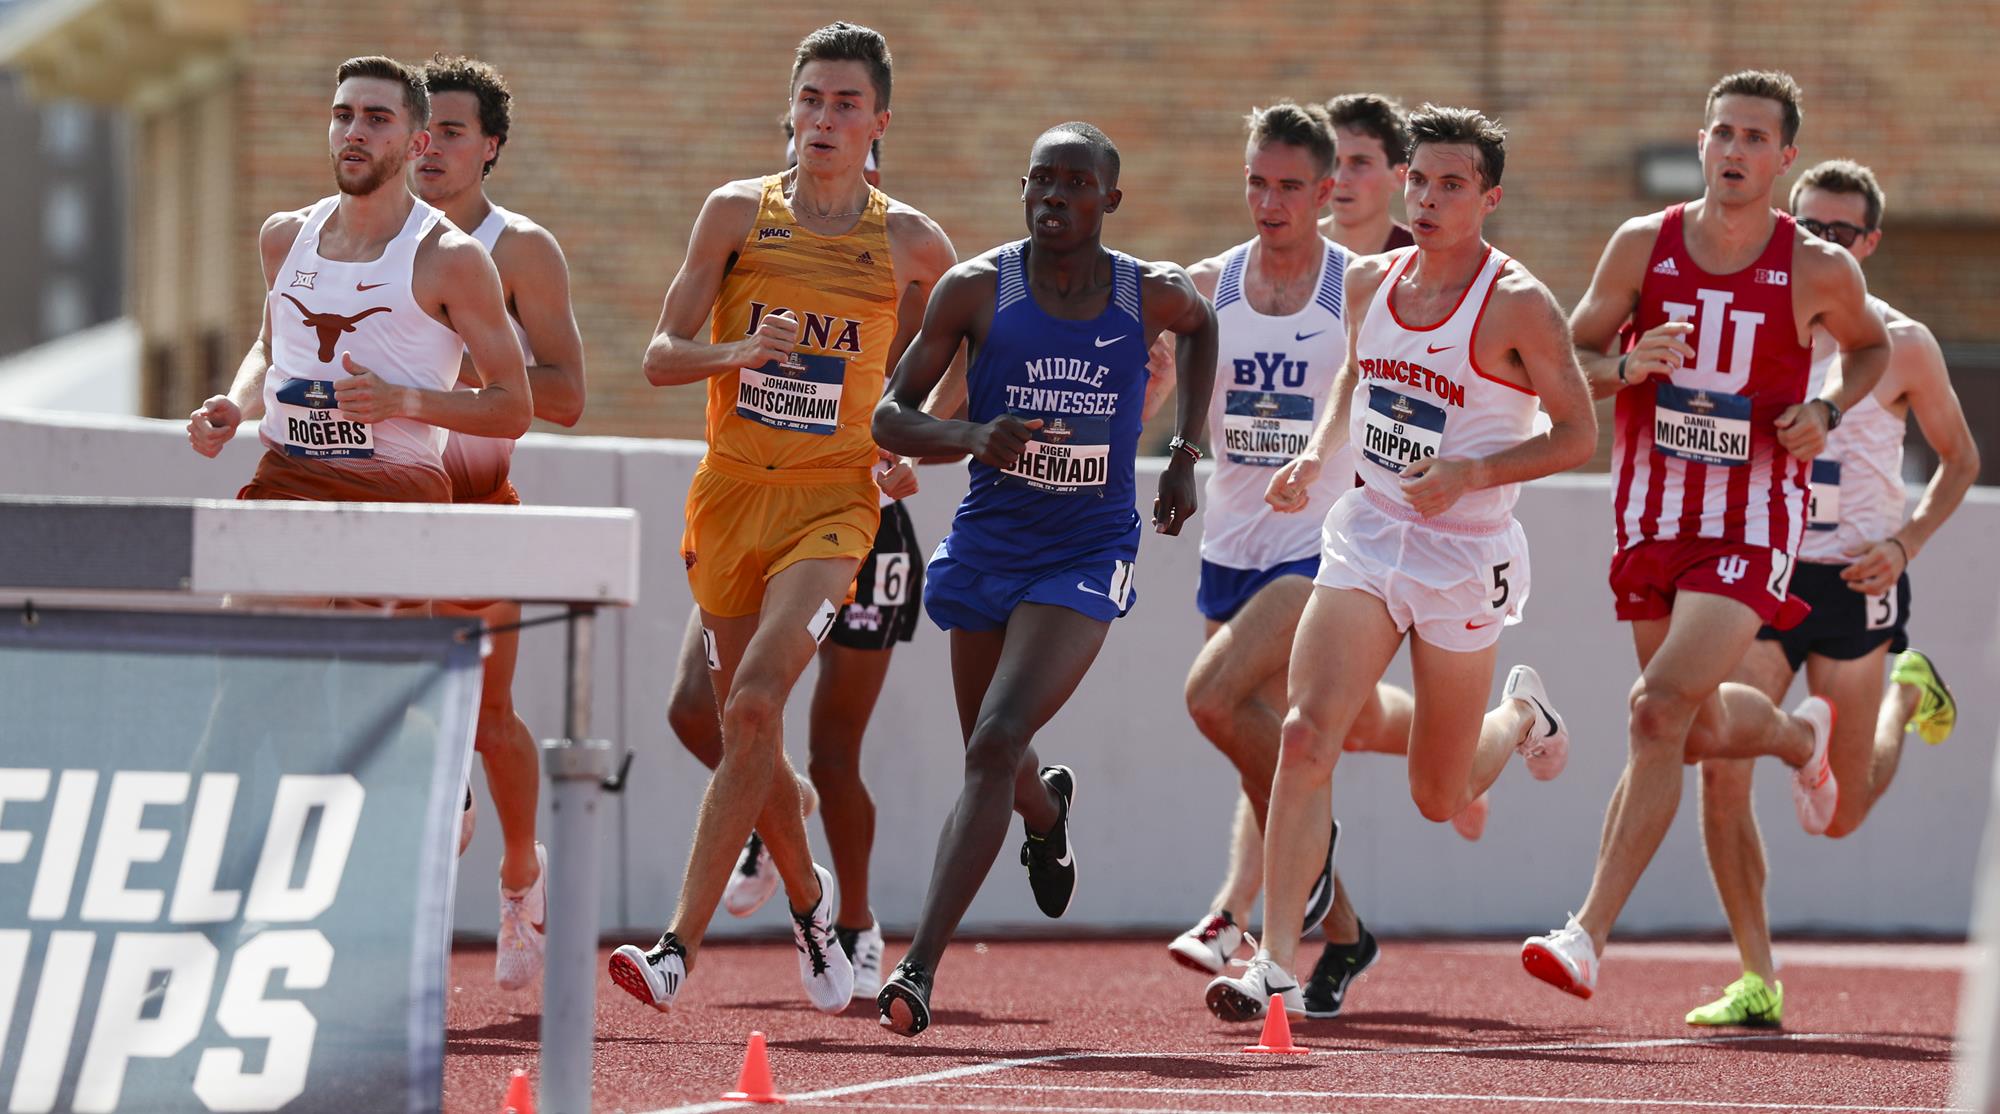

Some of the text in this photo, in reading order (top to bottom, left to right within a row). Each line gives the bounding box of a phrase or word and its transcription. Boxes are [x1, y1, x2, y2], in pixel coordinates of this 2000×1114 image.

[758, 227, 791, 241] MAAC
[745, 301, 863, 353] INA
[762, 377, 817, 395] JOHANNES
[1025, 357, 1109, 388] MIDDLE
[1232, 352, 1308, 391] BYU
[739, 382, 838, 420] MOTSCHMANN
[1006, 385, 1118, 415] TENNESSEE
[309, 410, 331, 421] ALEX
[1251, 419, 1281, 430] JACOB
[1393, 423, 1404, 435] ED
[1684, 415, 1717, 430] DANIEL
[288, 416, 367, 446] ROGERS
[1225, 428, 1309, 455] HESLINGTON
[1657, 420, 1747, 457] MICHALSKI
[1040, 444, 1072, 458] KIGEN
[885, 556, 902, 601] 6
[1492, 561, 1510, 609] 5
